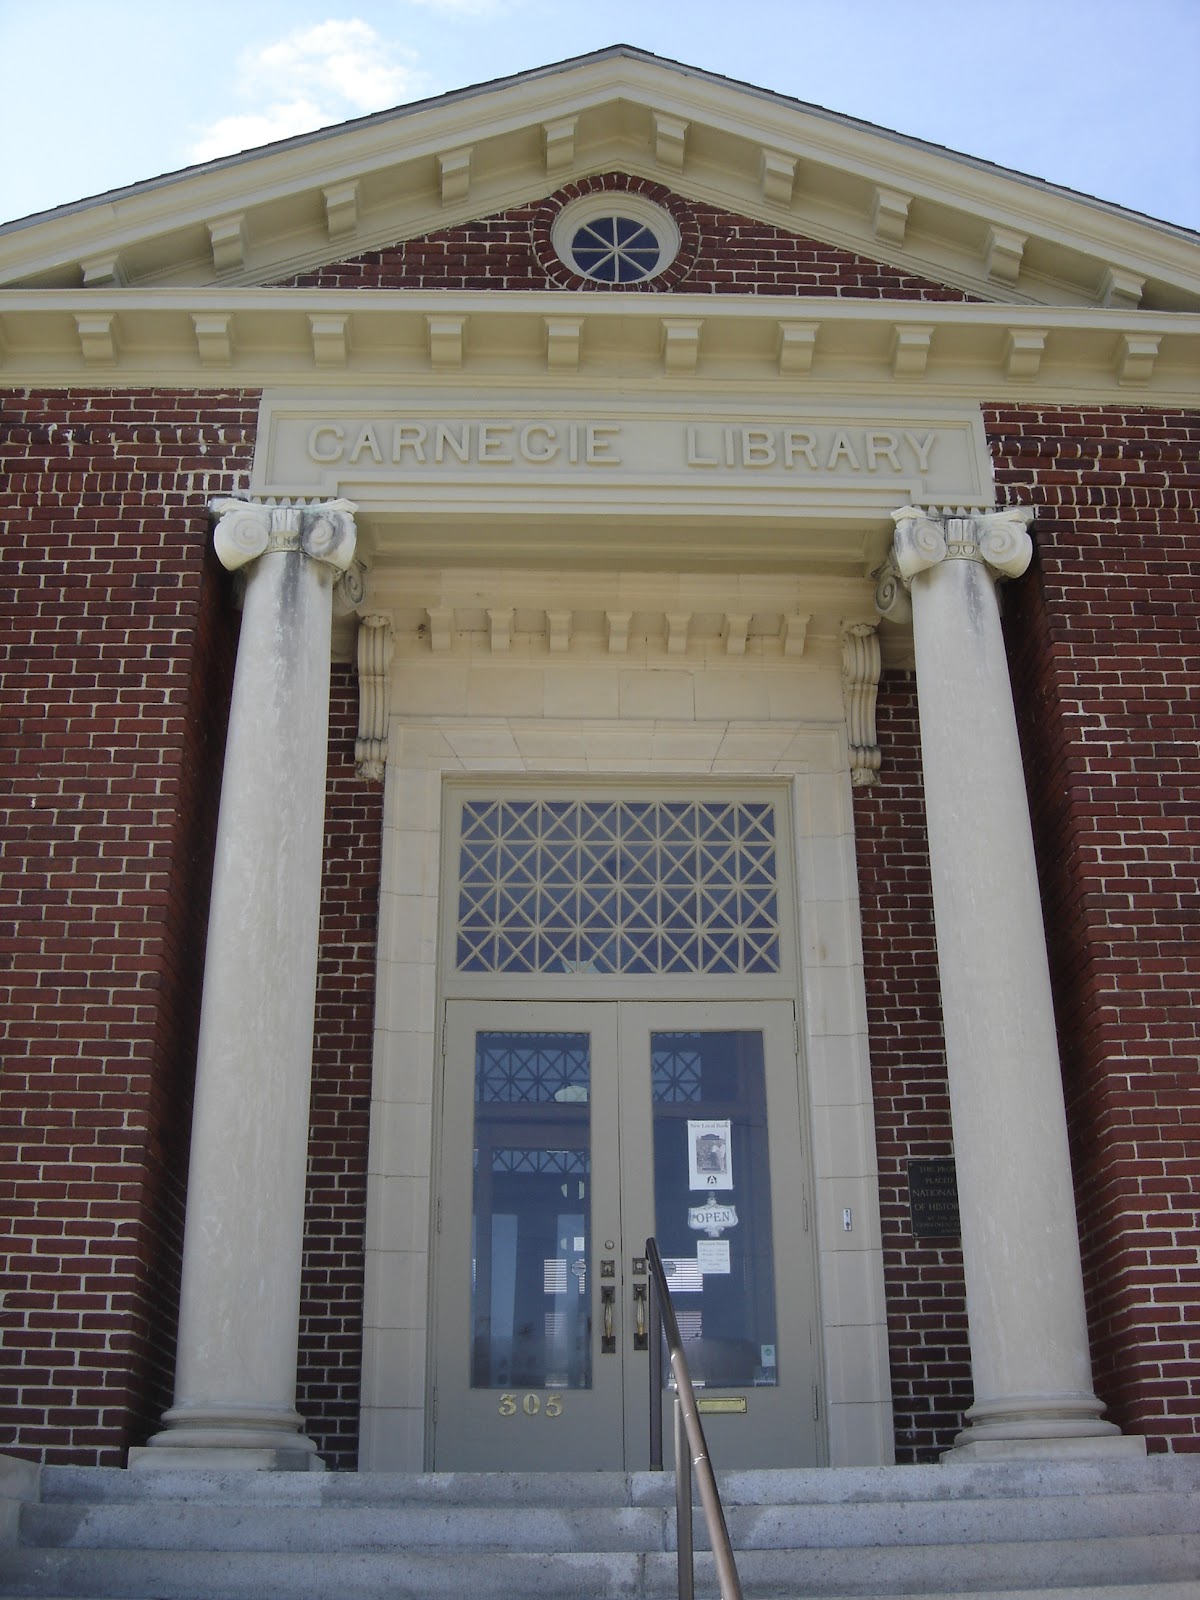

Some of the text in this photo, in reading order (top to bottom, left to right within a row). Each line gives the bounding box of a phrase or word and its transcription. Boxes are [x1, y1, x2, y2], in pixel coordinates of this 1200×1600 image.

[307, 422, 936, 473] CARNEGIE LIBRARY
[912, 1188, 956, 1197] NATIONAL
[914, 1203, 925, 1211] OF
[696, 1211, 730, 1223] OPEN
[498, 1393, 563, 1417] 305
